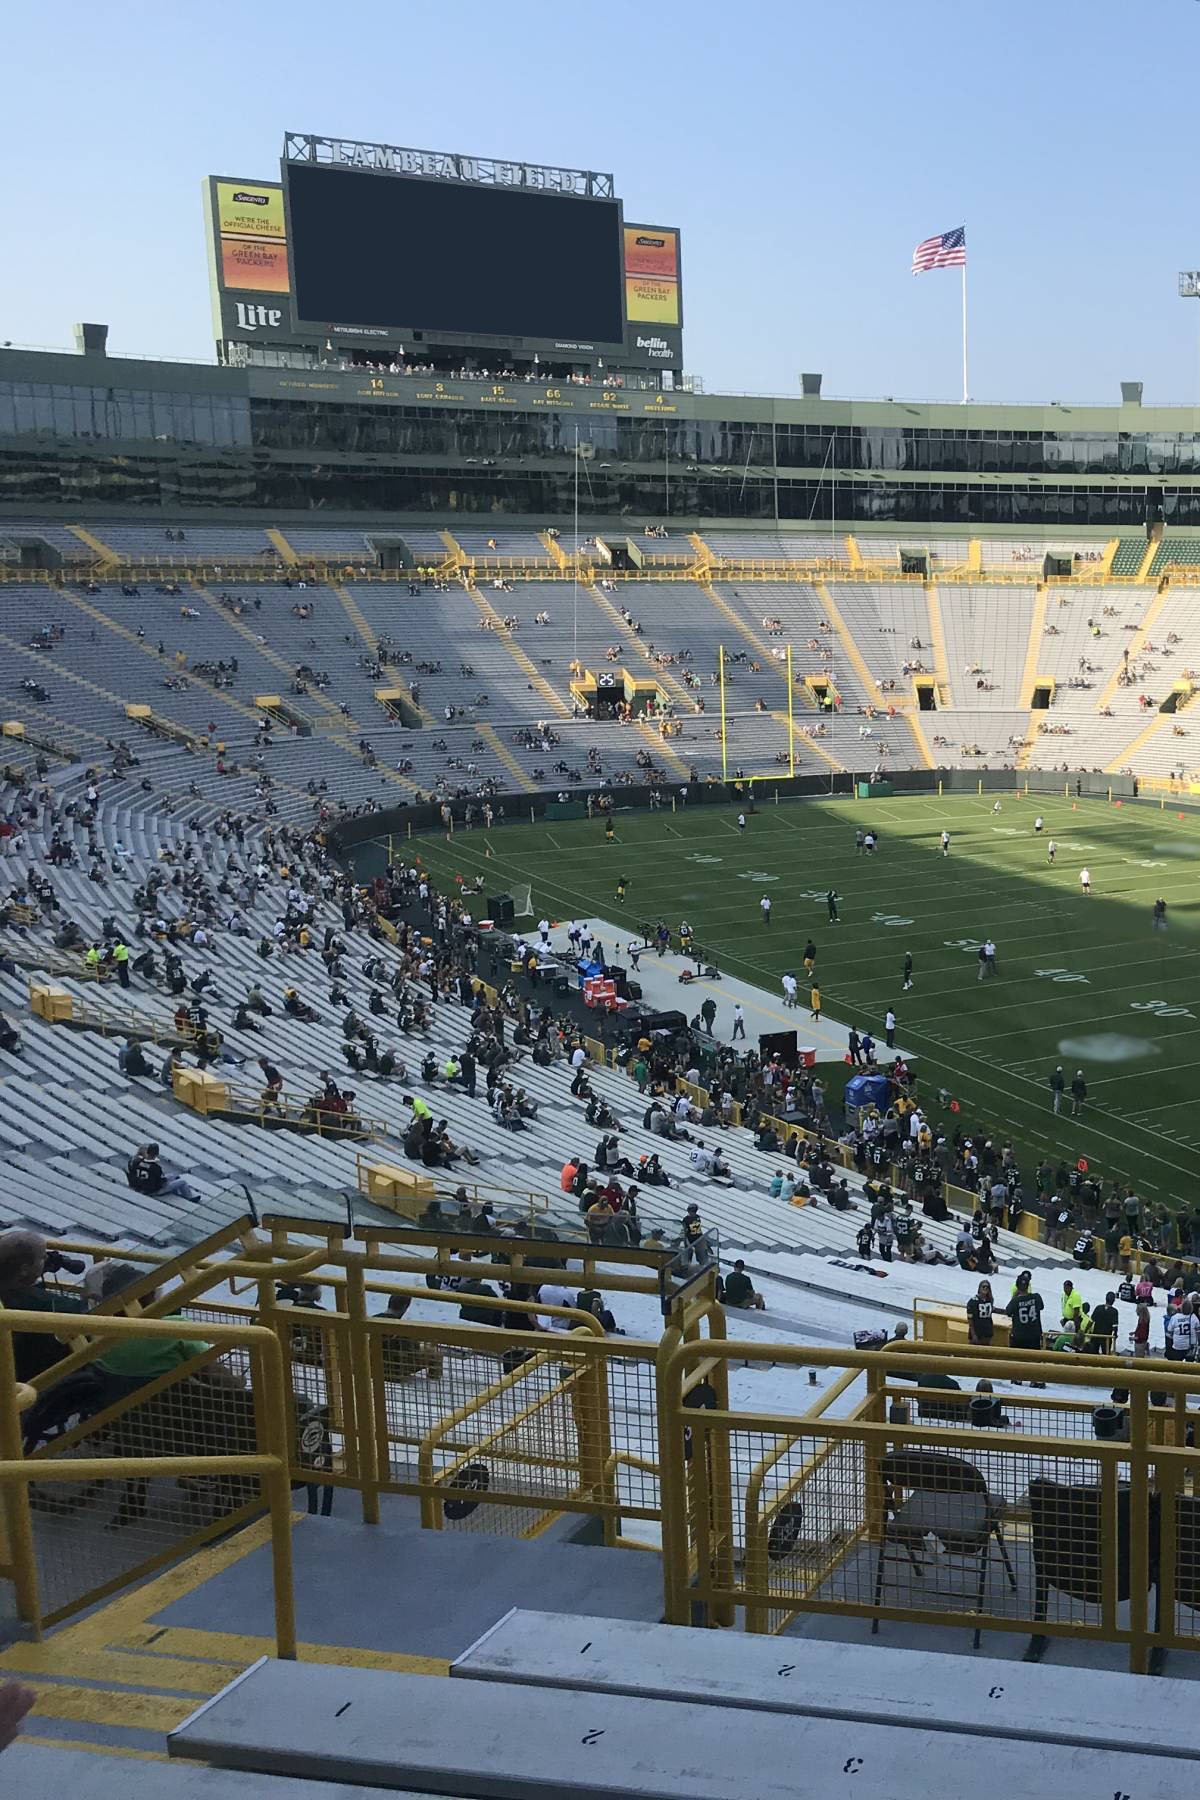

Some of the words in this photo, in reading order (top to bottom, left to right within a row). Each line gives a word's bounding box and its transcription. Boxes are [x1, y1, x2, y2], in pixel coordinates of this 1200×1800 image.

[331, 140, 480, 180] LAMBEAU
[494, 163, 577, 191] FIELD
[223, 221, 255, 230] OFFICIAL
[256, 224, 281, 232] CHEESE
[232, 250, 260, 259] GREEN
[262, 252, 278, 260] BAY
[236, 258, 274, 268] PACKERS
[634, 285, 657, 293] GREEN
[638, 292, 668, 302] PACKERS
[234, 302, 282, 331] Lite
[334, 326, 364, 335] MITSUBISHI
[555, 342, 578, 350] DIAMOND
[636, 336, 668, 349] bellin
[648, 348, 674, 359] health
[370, 379, 384, 389] 14
[435, 383, 444, 392] 3
[492, 386, 505, 396] 15
[546, 389, 561, 399] 66
[602, 392, 617, 402] 92
[600, 674, 614, 686] 25
[1033, 968, 1086, 983] 40
[1130, 1000, 1190, 1018] 30
[978, 1302, 993, 1319] 87
[1018, 1308, 1038, 1325] 64
[1178, 1322, 1191, 1336] 12
[777, 1664, 796, 1677] 2
[988, 1686, 1004, 1699] 3
[582, 1728, 605, 1745] 2
[844, 1756, 864, 1775] 3
